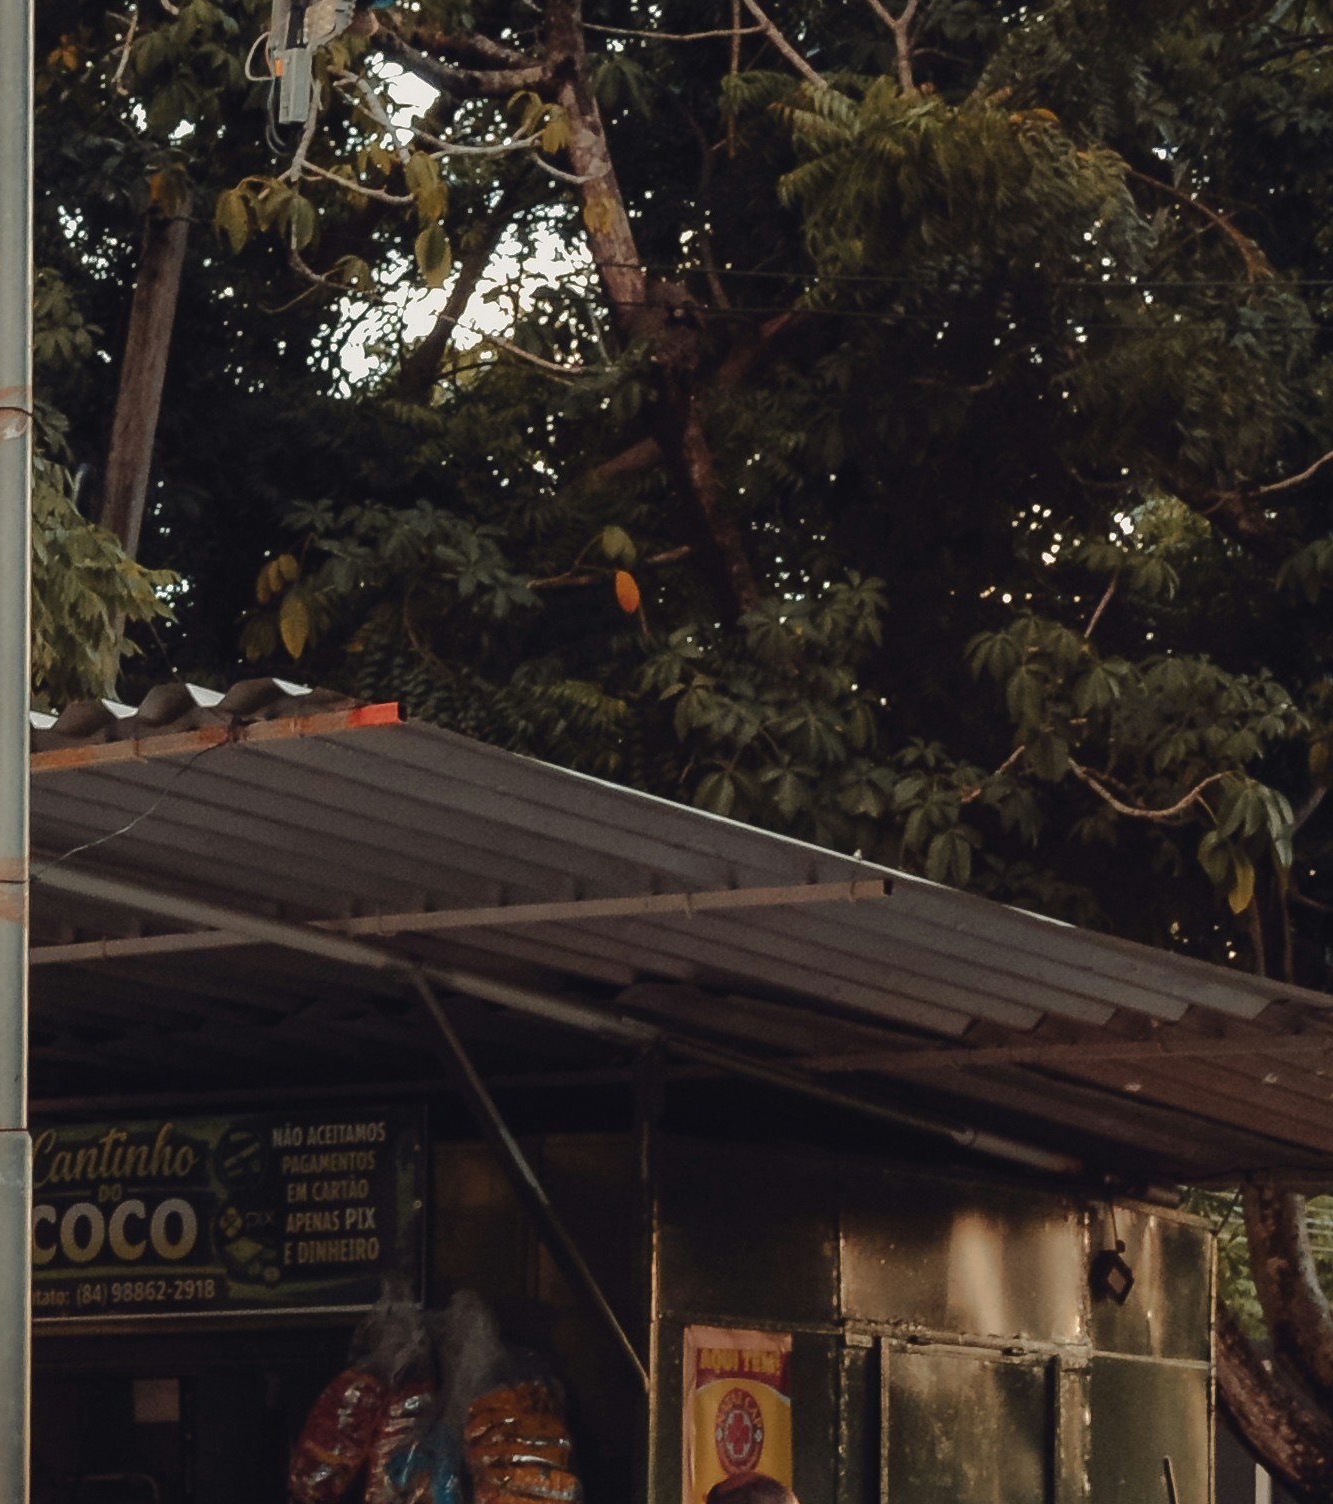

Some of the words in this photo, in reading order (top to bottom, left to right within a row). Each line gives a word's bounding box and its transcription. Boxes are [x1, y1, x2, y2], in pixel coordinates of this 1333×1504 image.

[272, 1122, 303, 1148] NÃO
[307, 1121, 386, 1146] ACEITAMOS
[32, 1121, 199, 1189] Cantinho
[281, 1150, 376, 1175] PAGAMENTOS
[97, 1183, 122, 1202] DO
[286, 1183, 308, 1204] EM
[312, 1174, 370, 1202] CARTÃO
[32, 1197, 198, 1265] COCO
[286, 1210, 340, 1234] APENAS
[345, 1207, 376, 1231] PIX
[284, 1241, 293, 1266] E
[297, 1237, 380, 1265] DINHEIRO
[77, 1283, 108, 1306] (84)
[112, 1279, 215, 1303] 98862-2918
